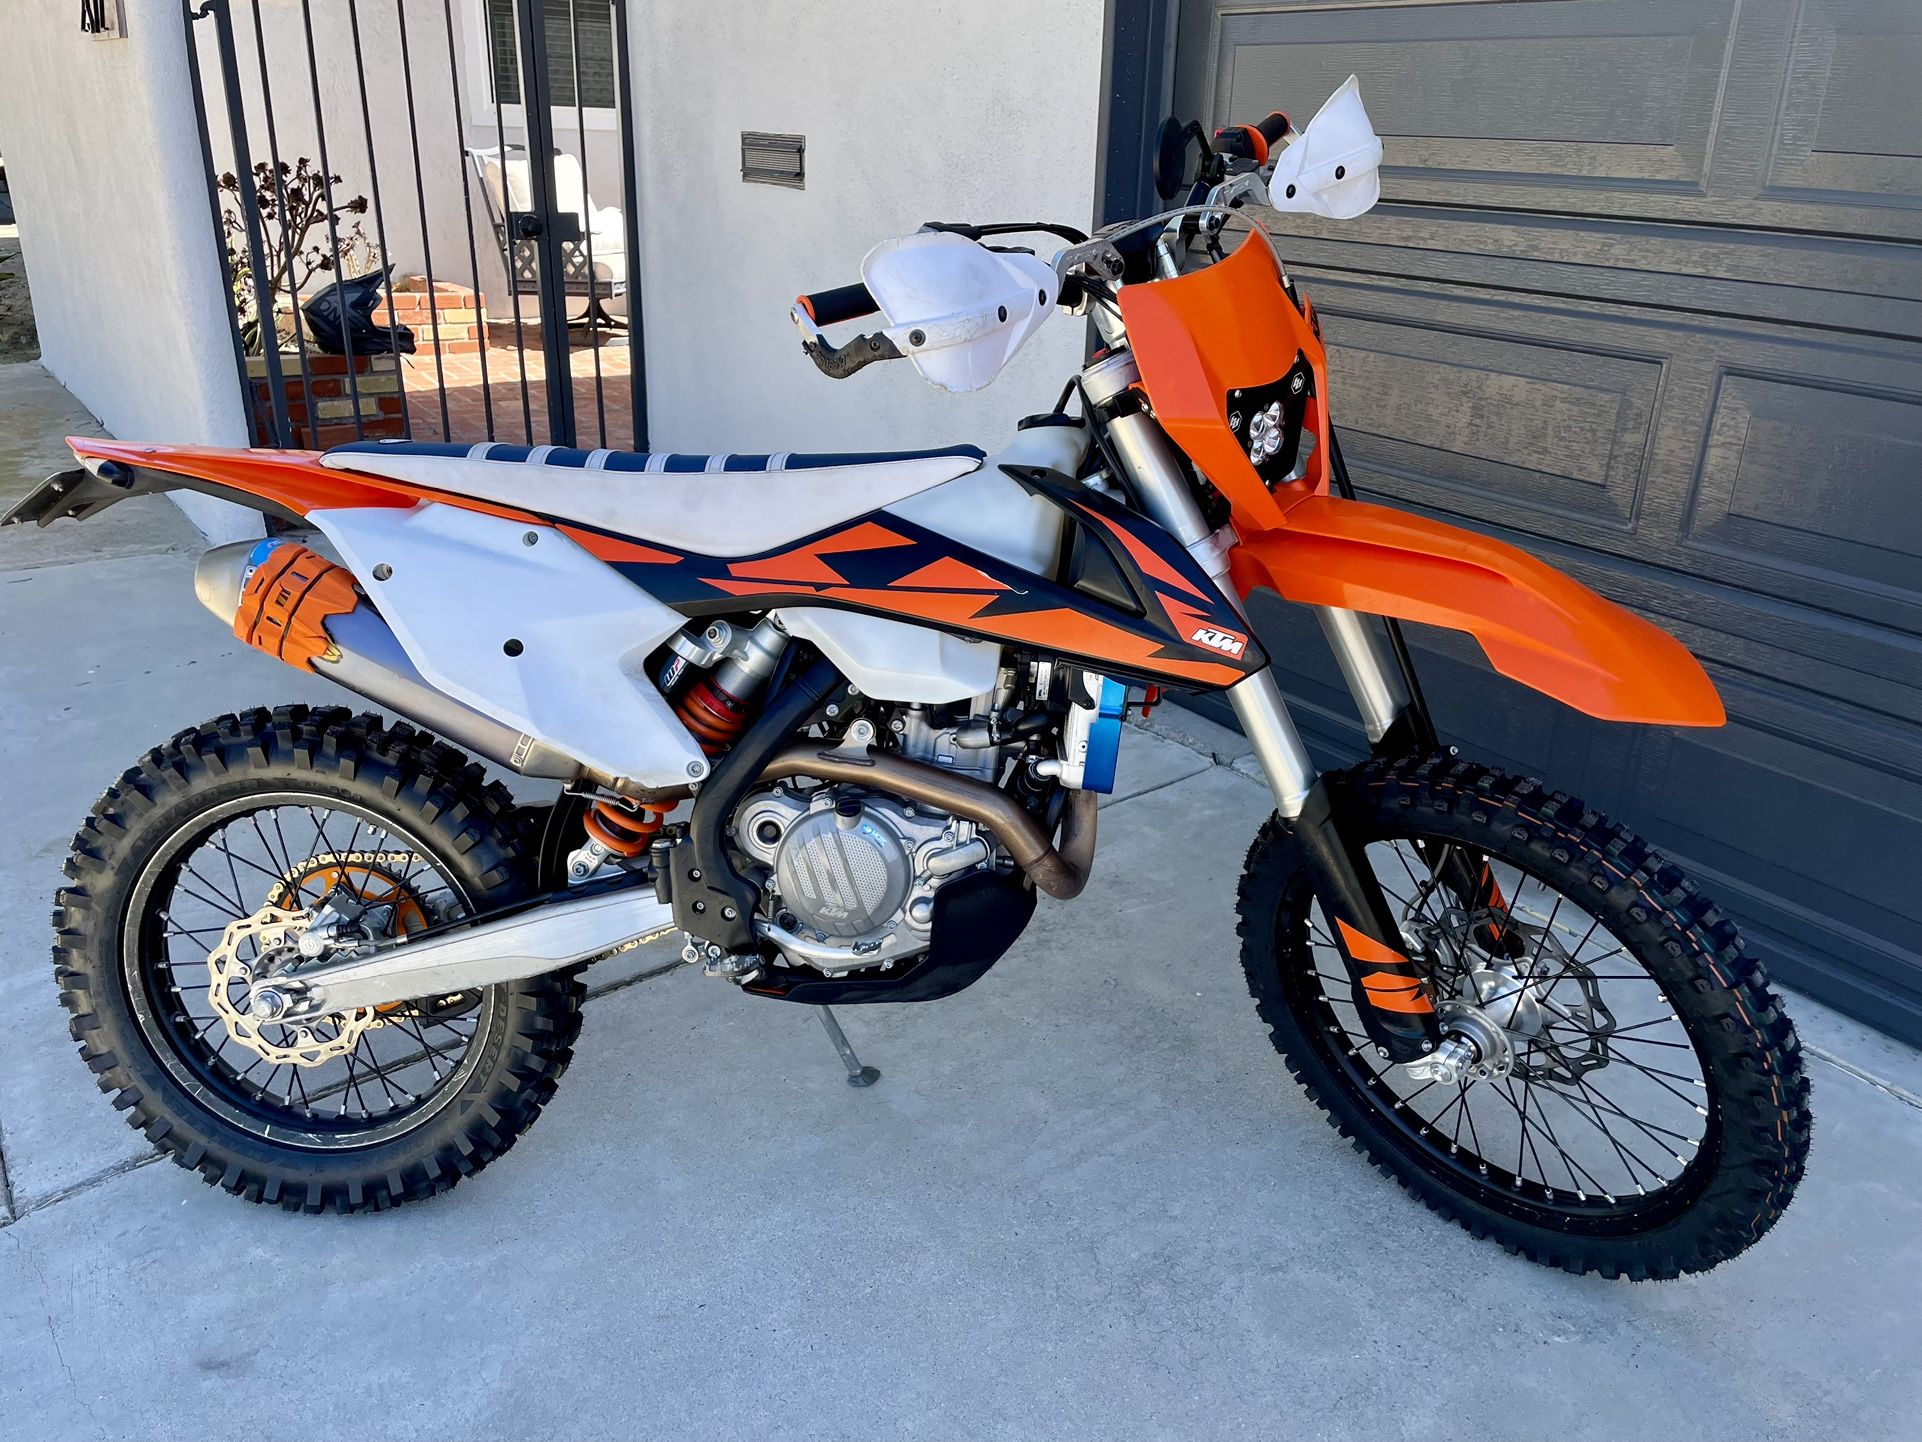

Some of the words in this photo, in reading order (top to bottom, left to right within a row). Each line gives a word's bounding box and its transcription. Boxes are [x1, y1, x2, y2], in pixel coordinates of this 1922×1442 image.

[1190, 628, 1244, 656] KTM
[819, 906, 849, 920] KTM
[480, 1003, 508, 1088] DESERT
